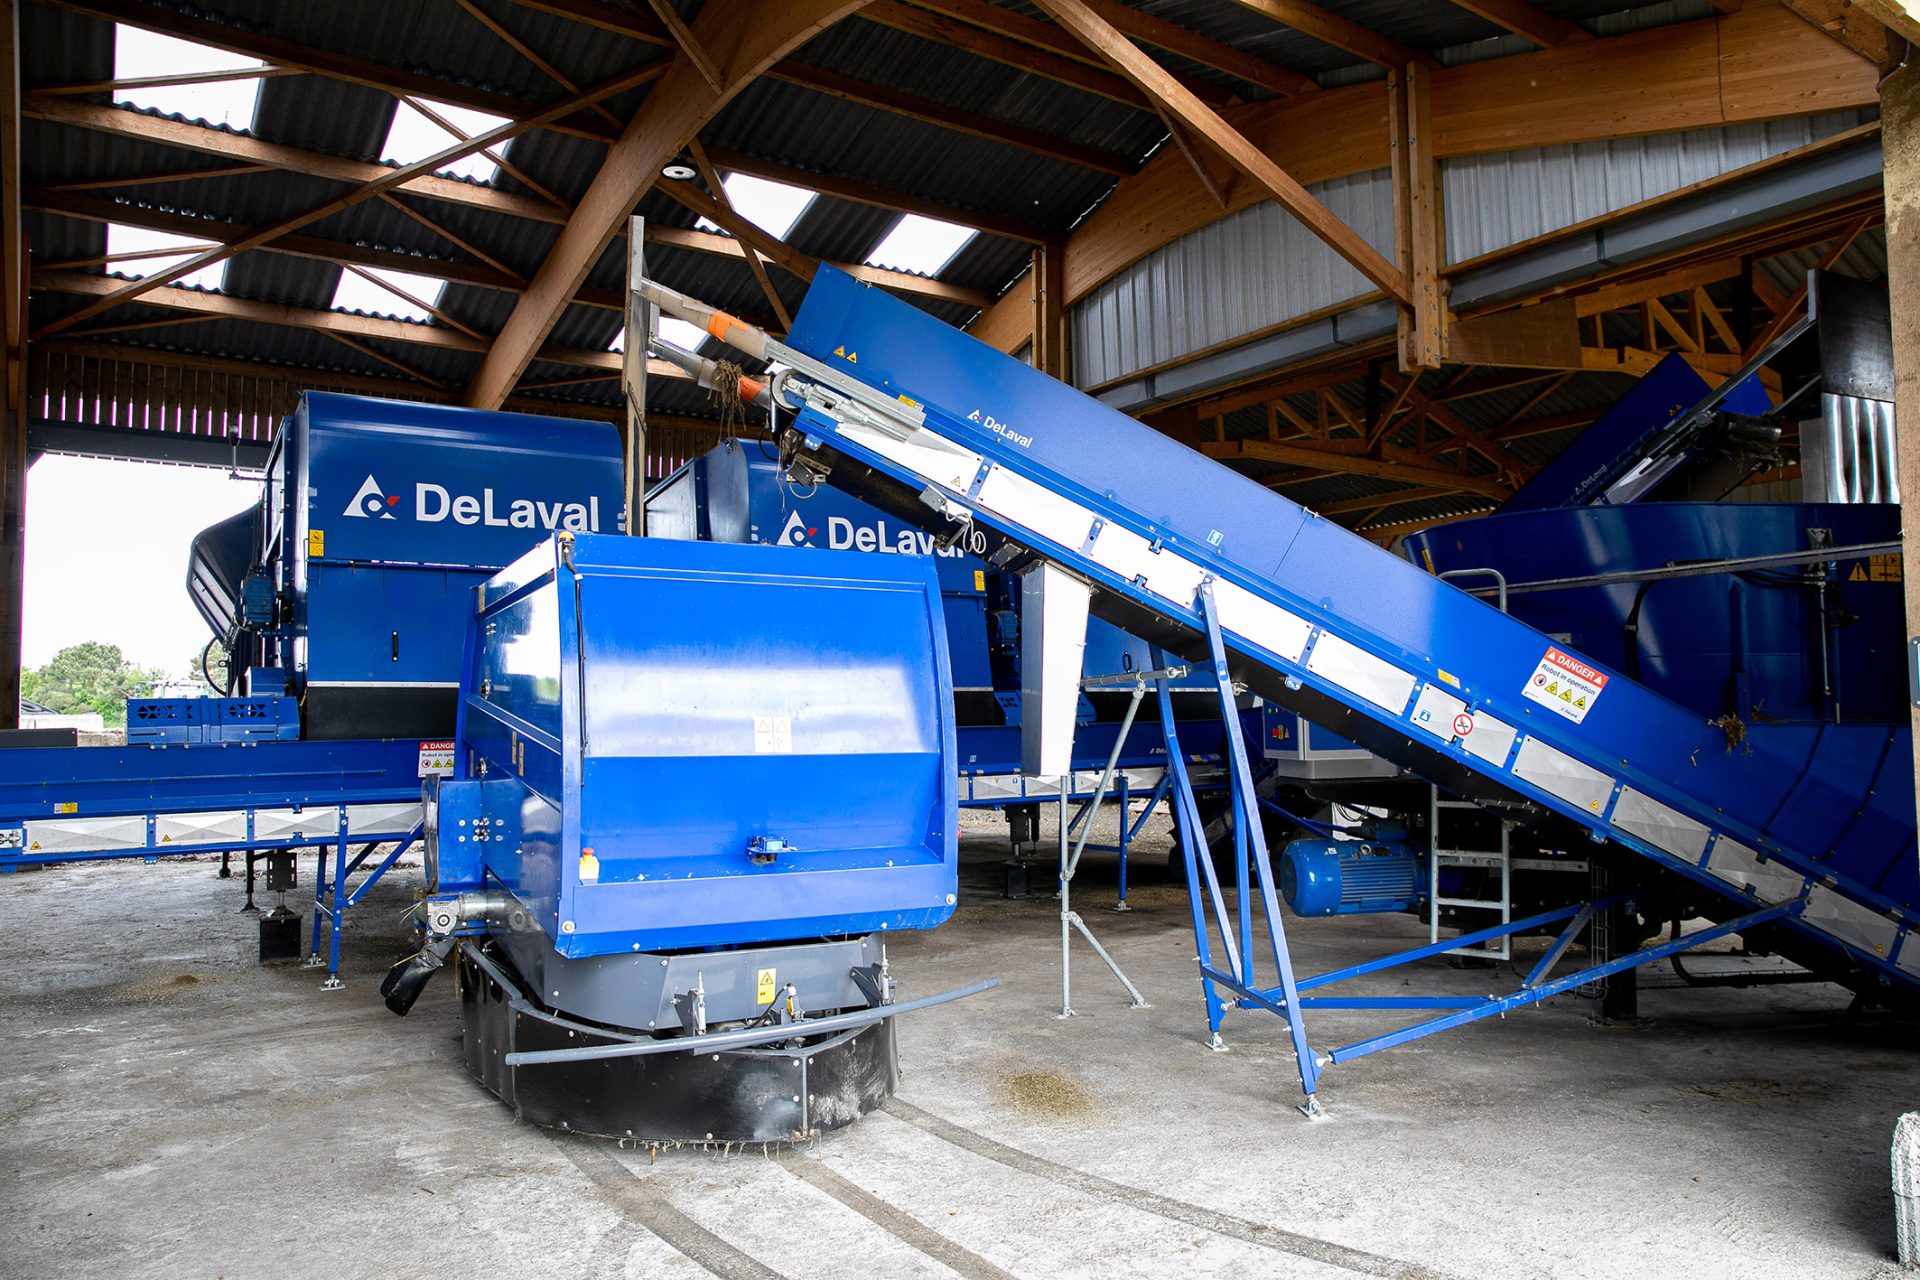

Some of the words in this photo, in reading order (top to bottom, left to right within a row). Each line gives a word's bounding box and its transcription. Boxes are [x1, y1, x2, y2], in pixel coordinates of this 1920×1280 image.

[983, 415, 1033, 448] DeLaval
[416, 482, 599, 532] DeLaval
[1541, 663, 1560, 678] Robot
[1560, 672, 1567, 680] in
[1566, 678, 1596, 696] operation
[1556, 655, 1595, 680] DANGER
